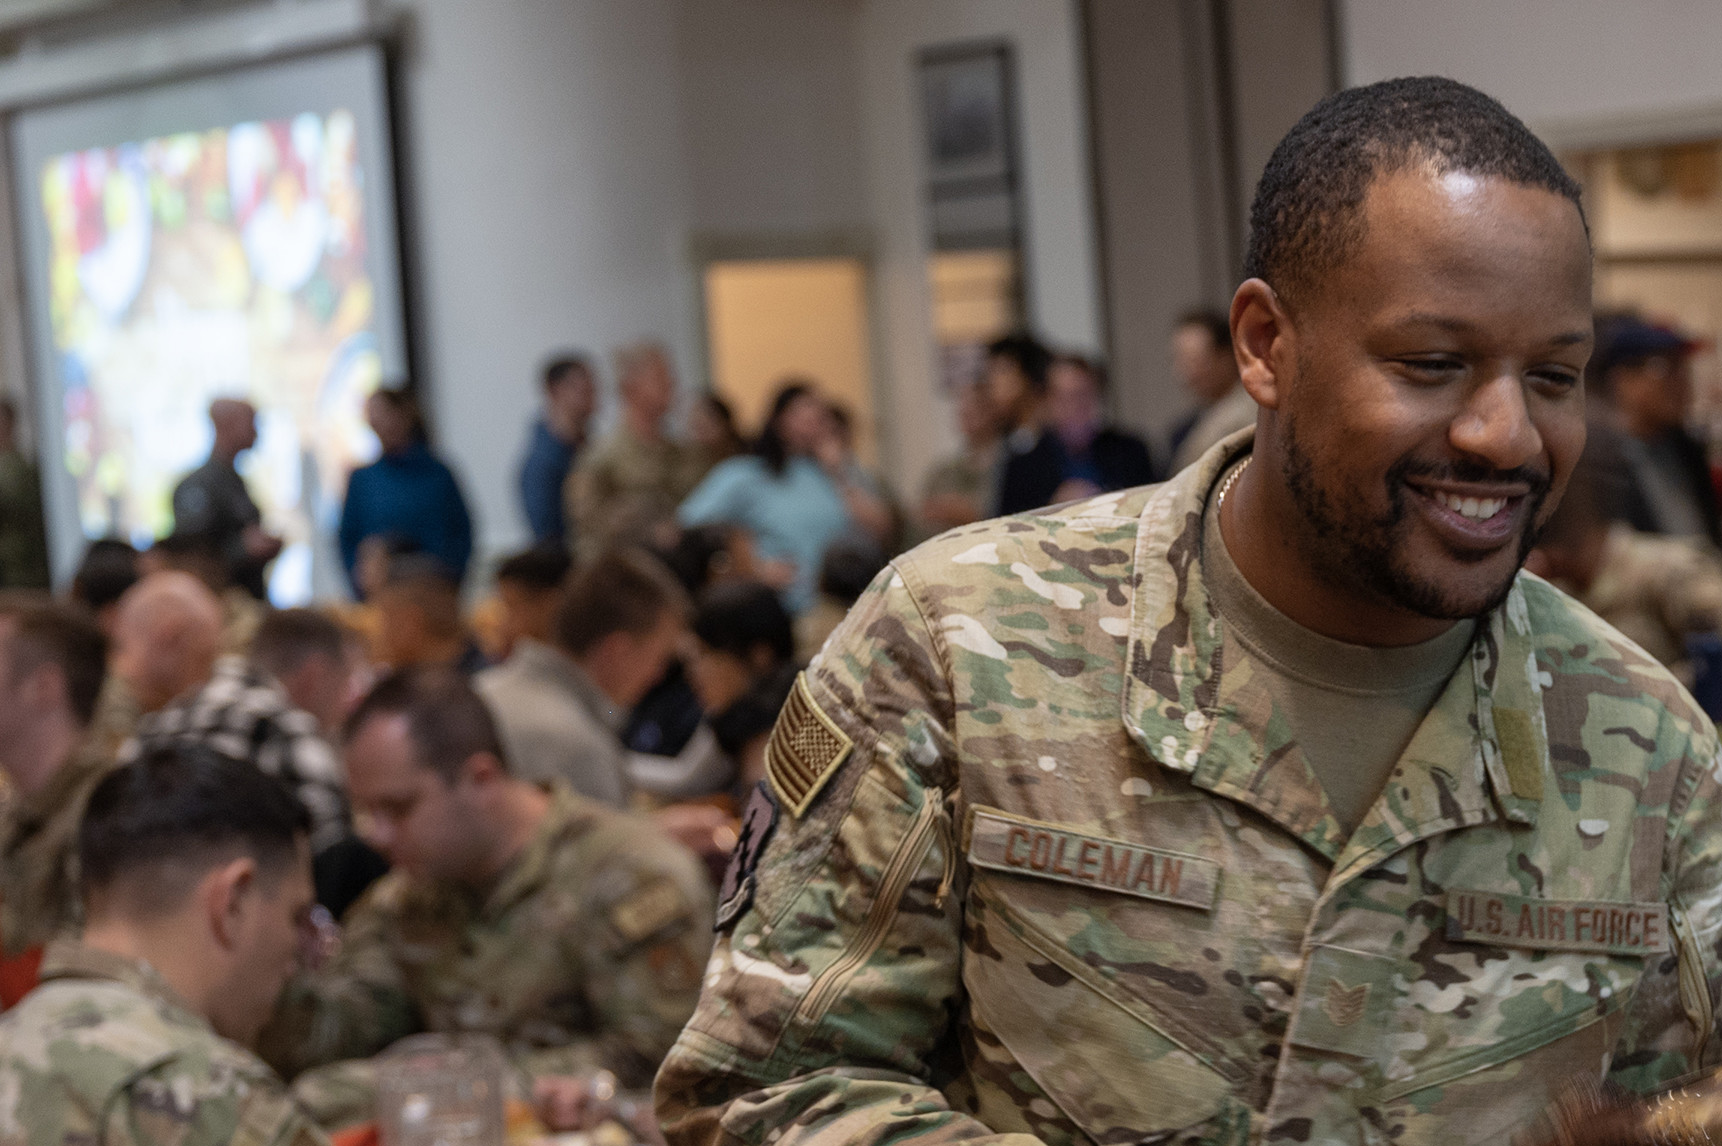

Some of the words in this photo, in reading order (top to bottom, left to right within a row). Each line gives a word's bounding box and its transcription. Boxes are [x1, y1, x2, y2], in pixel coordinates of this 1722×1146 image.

[1004, 826, 1184, 896] COLEMAN
[1457, 896, 1510, 937] U.S.
[1516, 903, 1566, 940] AIR
[1572, 907, 1660, 946] FORCE
